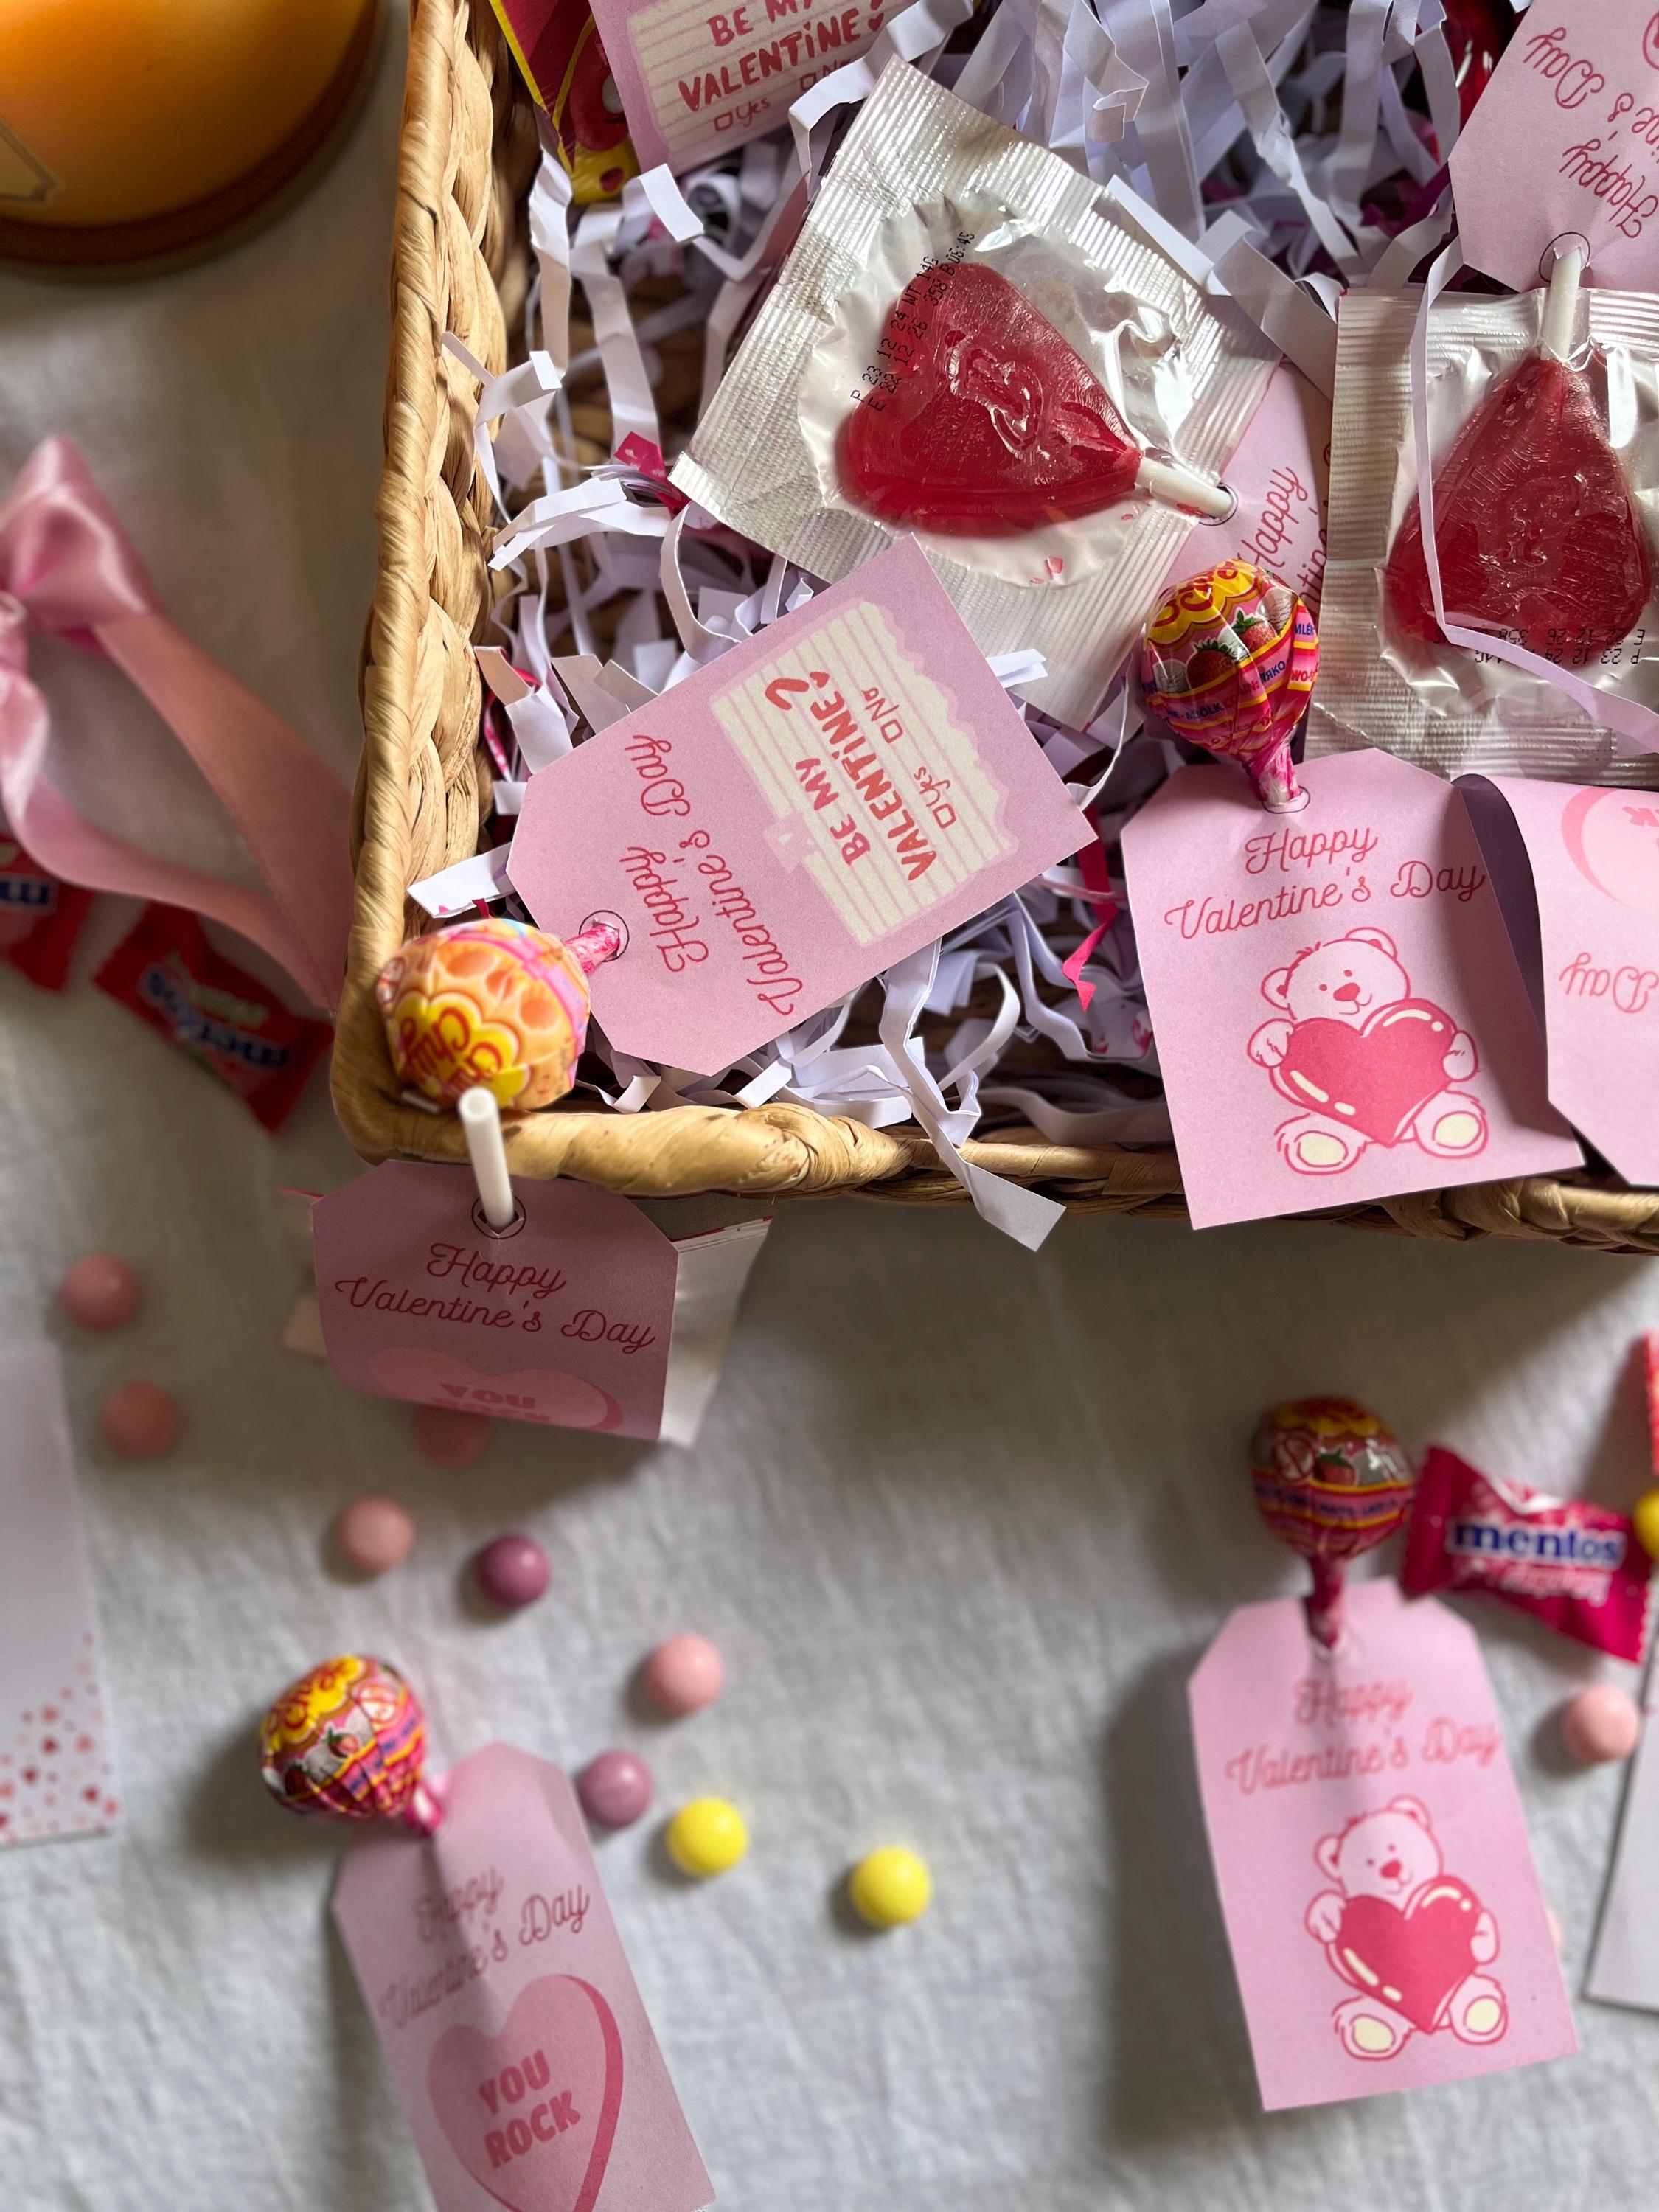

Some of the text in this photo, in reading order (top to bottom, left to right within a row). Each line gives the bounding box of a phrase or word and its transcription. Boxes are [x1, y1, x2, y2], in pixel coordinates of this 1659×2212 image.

[707, 0, 813, 47] BE M
[1523, 27, 1604, 109] Day
[1559, 138, 1659, 238] Happy
[850, 389, 864, 403] P
[861, 366, 882, 385] 23
[877, 338, 897, 359] 12
[889, 310, 910, 333] 24
[868, 397, 886, 412] E
[879, 373, 902, 394] 22
[894, 344, 916, 366] 12
[907, 318, 928, 341] 26
[922, 279, 948, 307] 358
[1571, 648, 1590, 664] 12
[1600, 648, 1622, 664] 23
[1630, 648, 1640, 664] P
[1634, 629, 1645, 646] E
[795, 758, 871, 866] BE MY
[625, 734, 803, 1016] Valentine's Day
[1244, 827, 1378, 874] Happy
[619, 846, 709, 973] Happy
[1164, 860, 1486, 939] Valentine's Day
[1559, 951, 1659, 1014] Day
[426, 1242, 567, 1300] Happy
[335, 1276, 656, 1354] Valentine's Day
[440, 1382, 536, 1410] YOU
[1453, 1520, 1624, 1565] mentos
[1293, 1677, 1413, 1728] Happy
[1224, 1715, 1502, 1795] Valentine's Day
[518, 1884, 590, 1947] Day
[477, 2049, 551, 2115] YOU
[483, 2090, 581, 2169] ROCK
